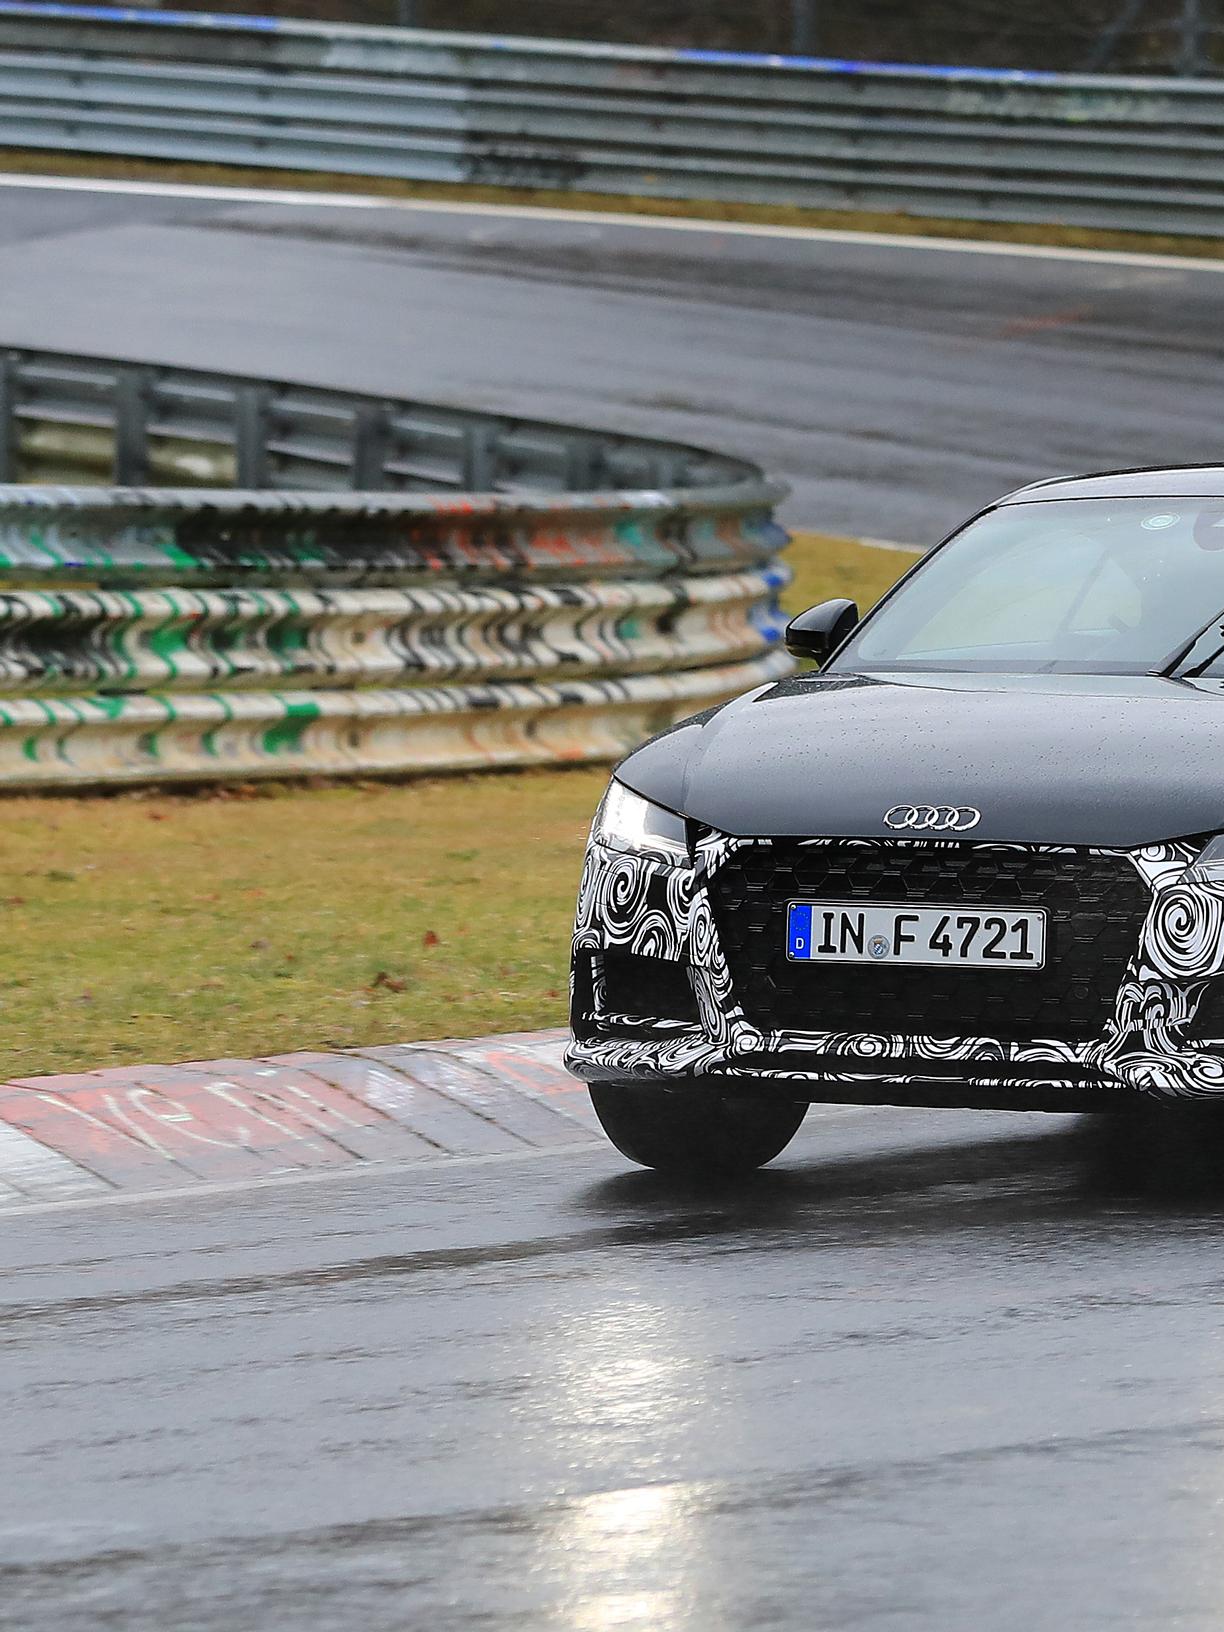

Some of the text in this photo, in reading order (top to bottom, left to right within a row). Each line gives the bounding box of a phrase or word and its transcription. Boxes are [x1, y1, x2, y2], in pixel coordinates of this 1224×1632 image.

[795, 937, 805, 950] D
[817, 912, 1034, 960] IN F 4721
